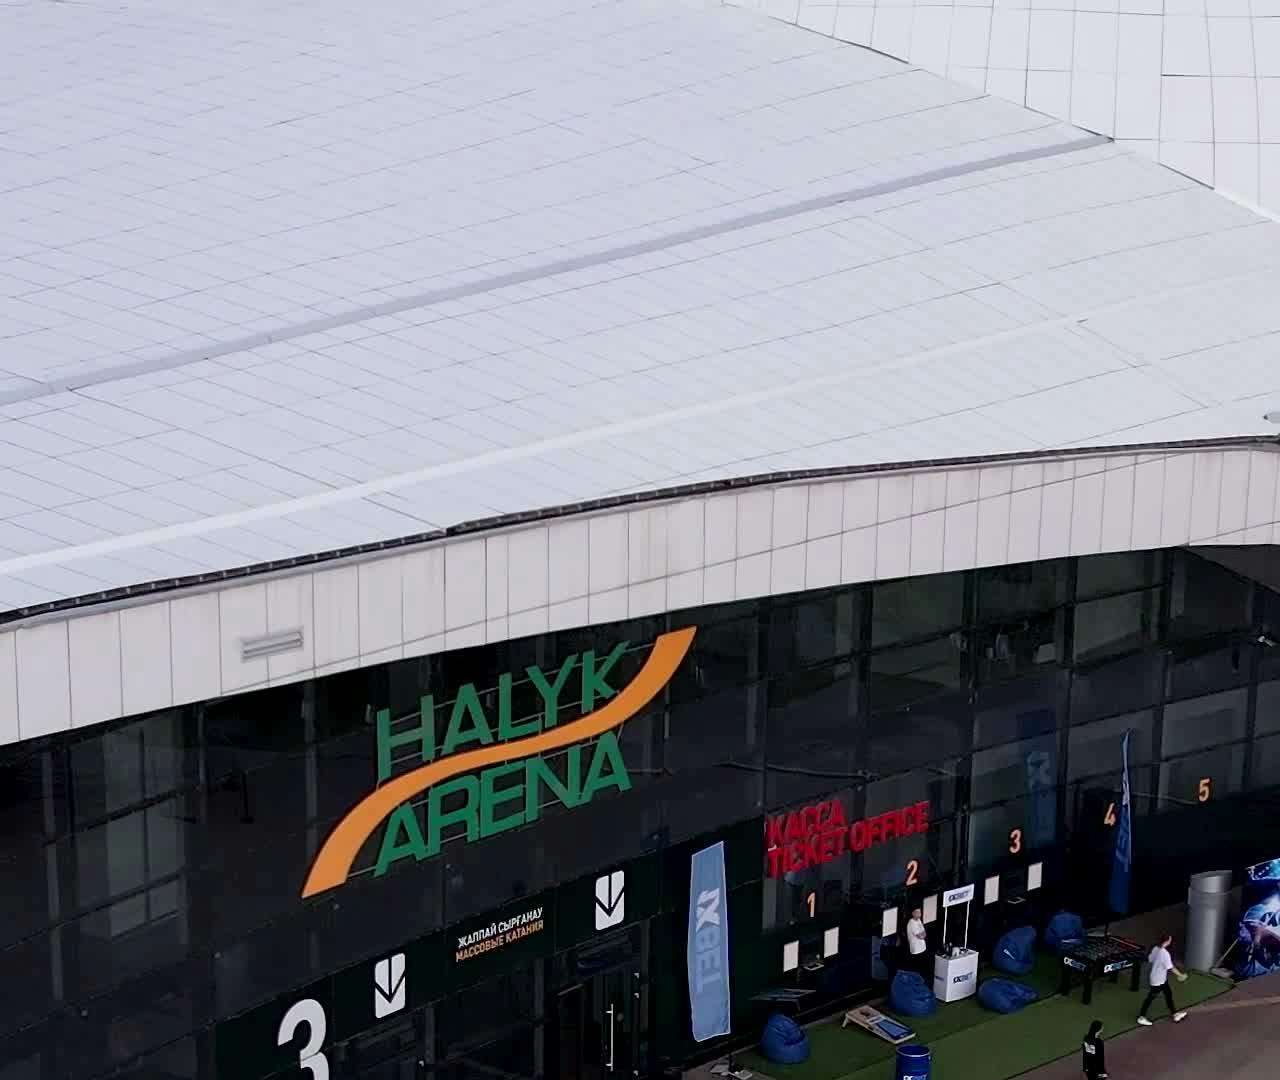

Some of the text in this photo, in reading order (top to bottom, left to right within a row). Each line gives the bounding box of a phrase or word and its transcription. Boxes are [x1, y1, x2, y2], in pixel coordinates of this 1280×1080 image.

[376, 641, 631, 783] HALYK
[1199, 778, 1210, 802] 5
[373, 731, 632, 878] ARENA
[1104, 803, 1116, 826] 4
[766, 800, 930, 880] TICKET OFFICE
[1009, 829, 1021, 853] 3
[906, 860, 918, 886] 2
[807, 892, 816, 918] 1
[456, 920, 544, 962] МАССОВЫЕ КАТАНИЯ
[458, 922, 497, 949] ЖАЛПАЙ
